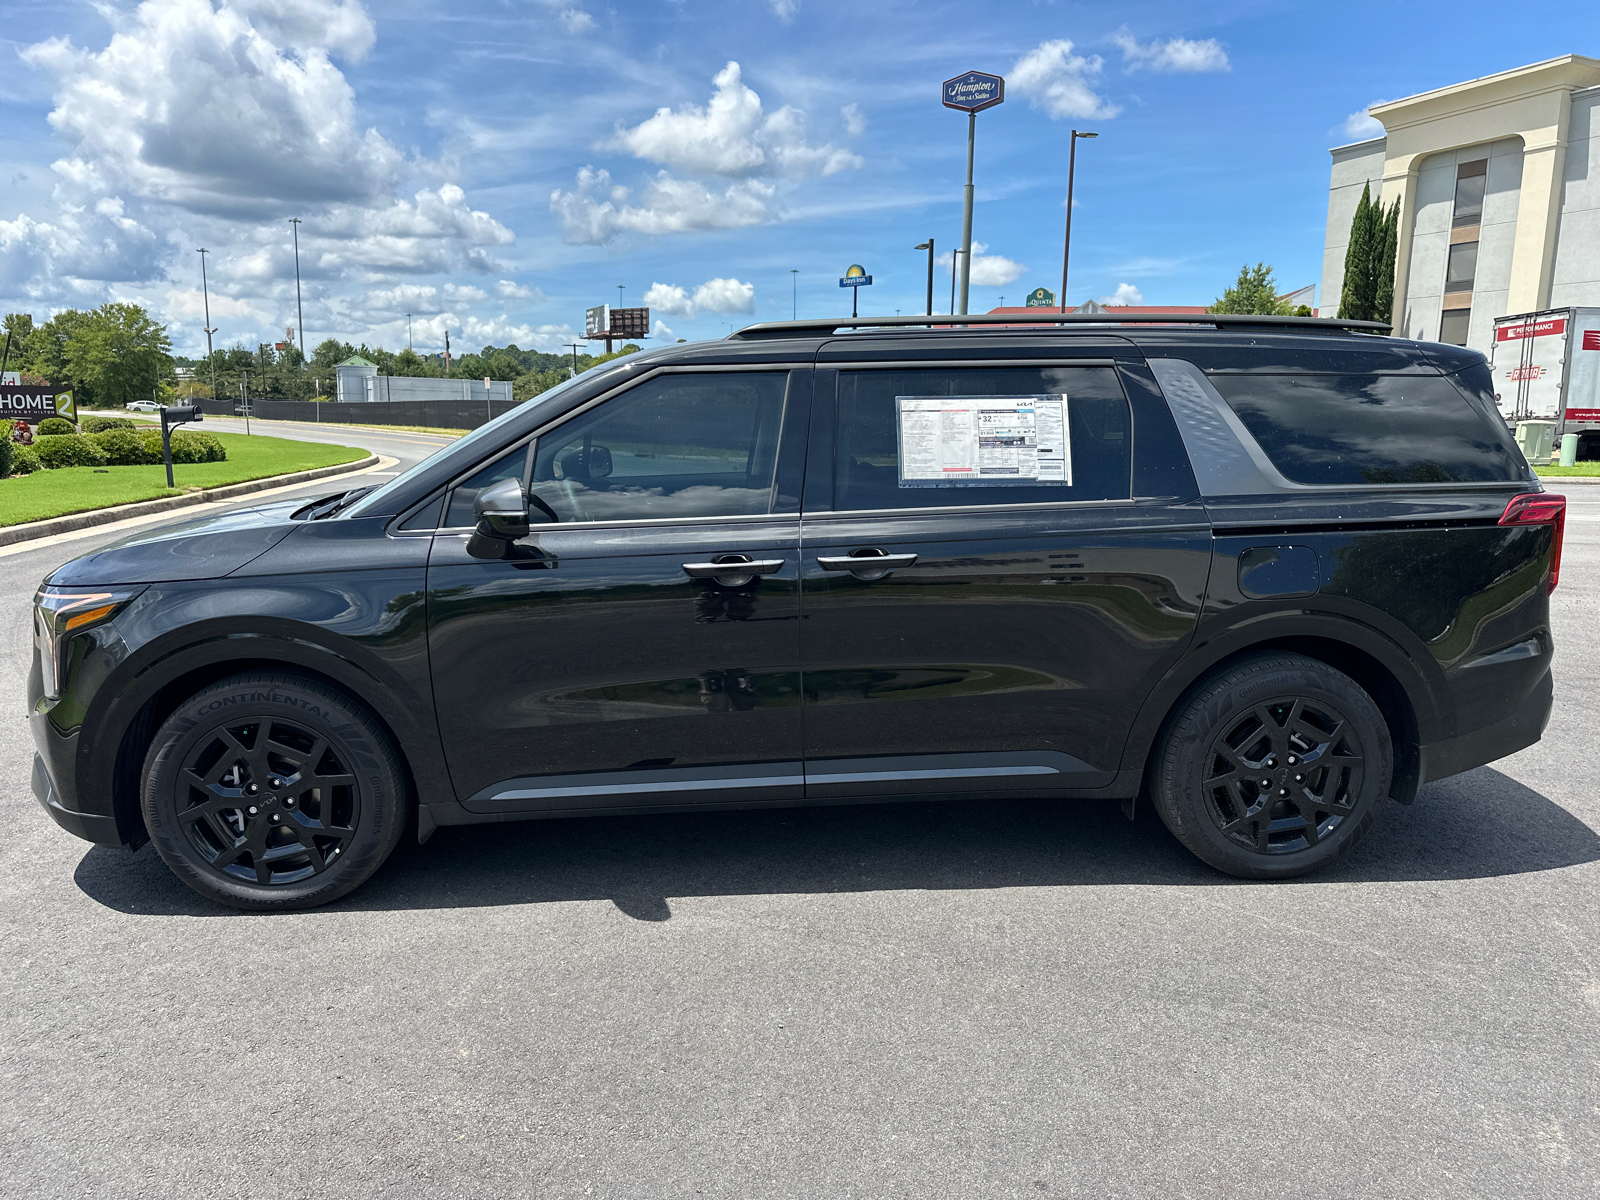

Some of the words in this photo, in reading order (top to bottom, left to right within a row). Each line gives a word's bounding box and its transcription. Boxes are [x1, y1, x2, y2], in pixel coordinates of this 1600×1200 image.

[949, 82, 995, 95] Hampton
[0, 394, 55, 410] HOME
[58, 394, 73, 417] 2
[1239, 674, 1289, 699] Continental
[197, 691, 331, 722] CONTINENTAL
[1355, 698, 1388, 807] CONNTAL
[370, 775, 384, 828] Continental
